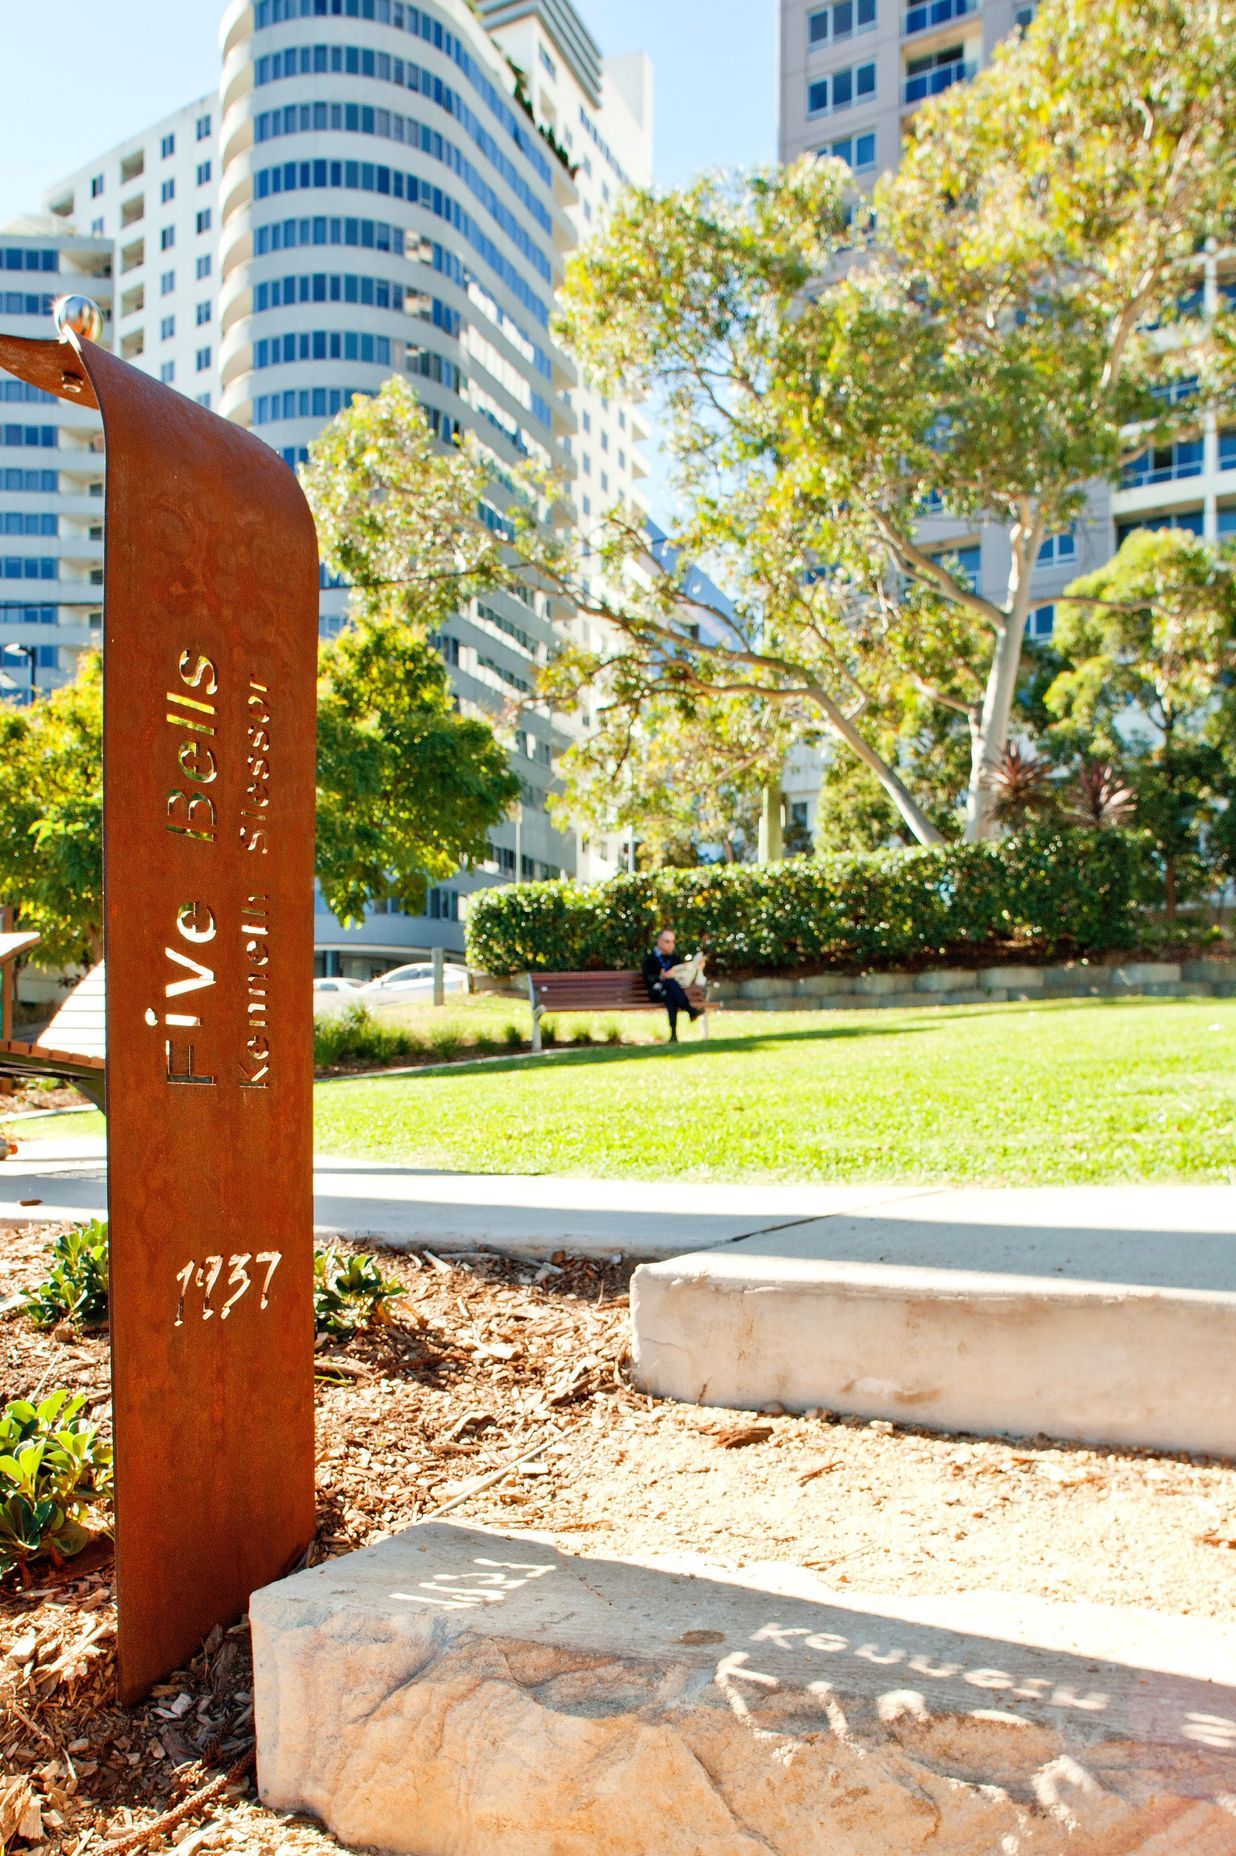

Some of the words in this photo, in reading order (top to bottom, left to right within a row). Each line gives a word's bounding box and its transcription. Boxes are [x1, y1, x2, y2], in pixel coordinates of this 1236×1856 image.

[165, 650, 218, 842] Bells
[240, 673, 270, 854] Slessor
[239, 891, 269, 1088] Kenneth
[174, 1250, 284, 1327] 1937
